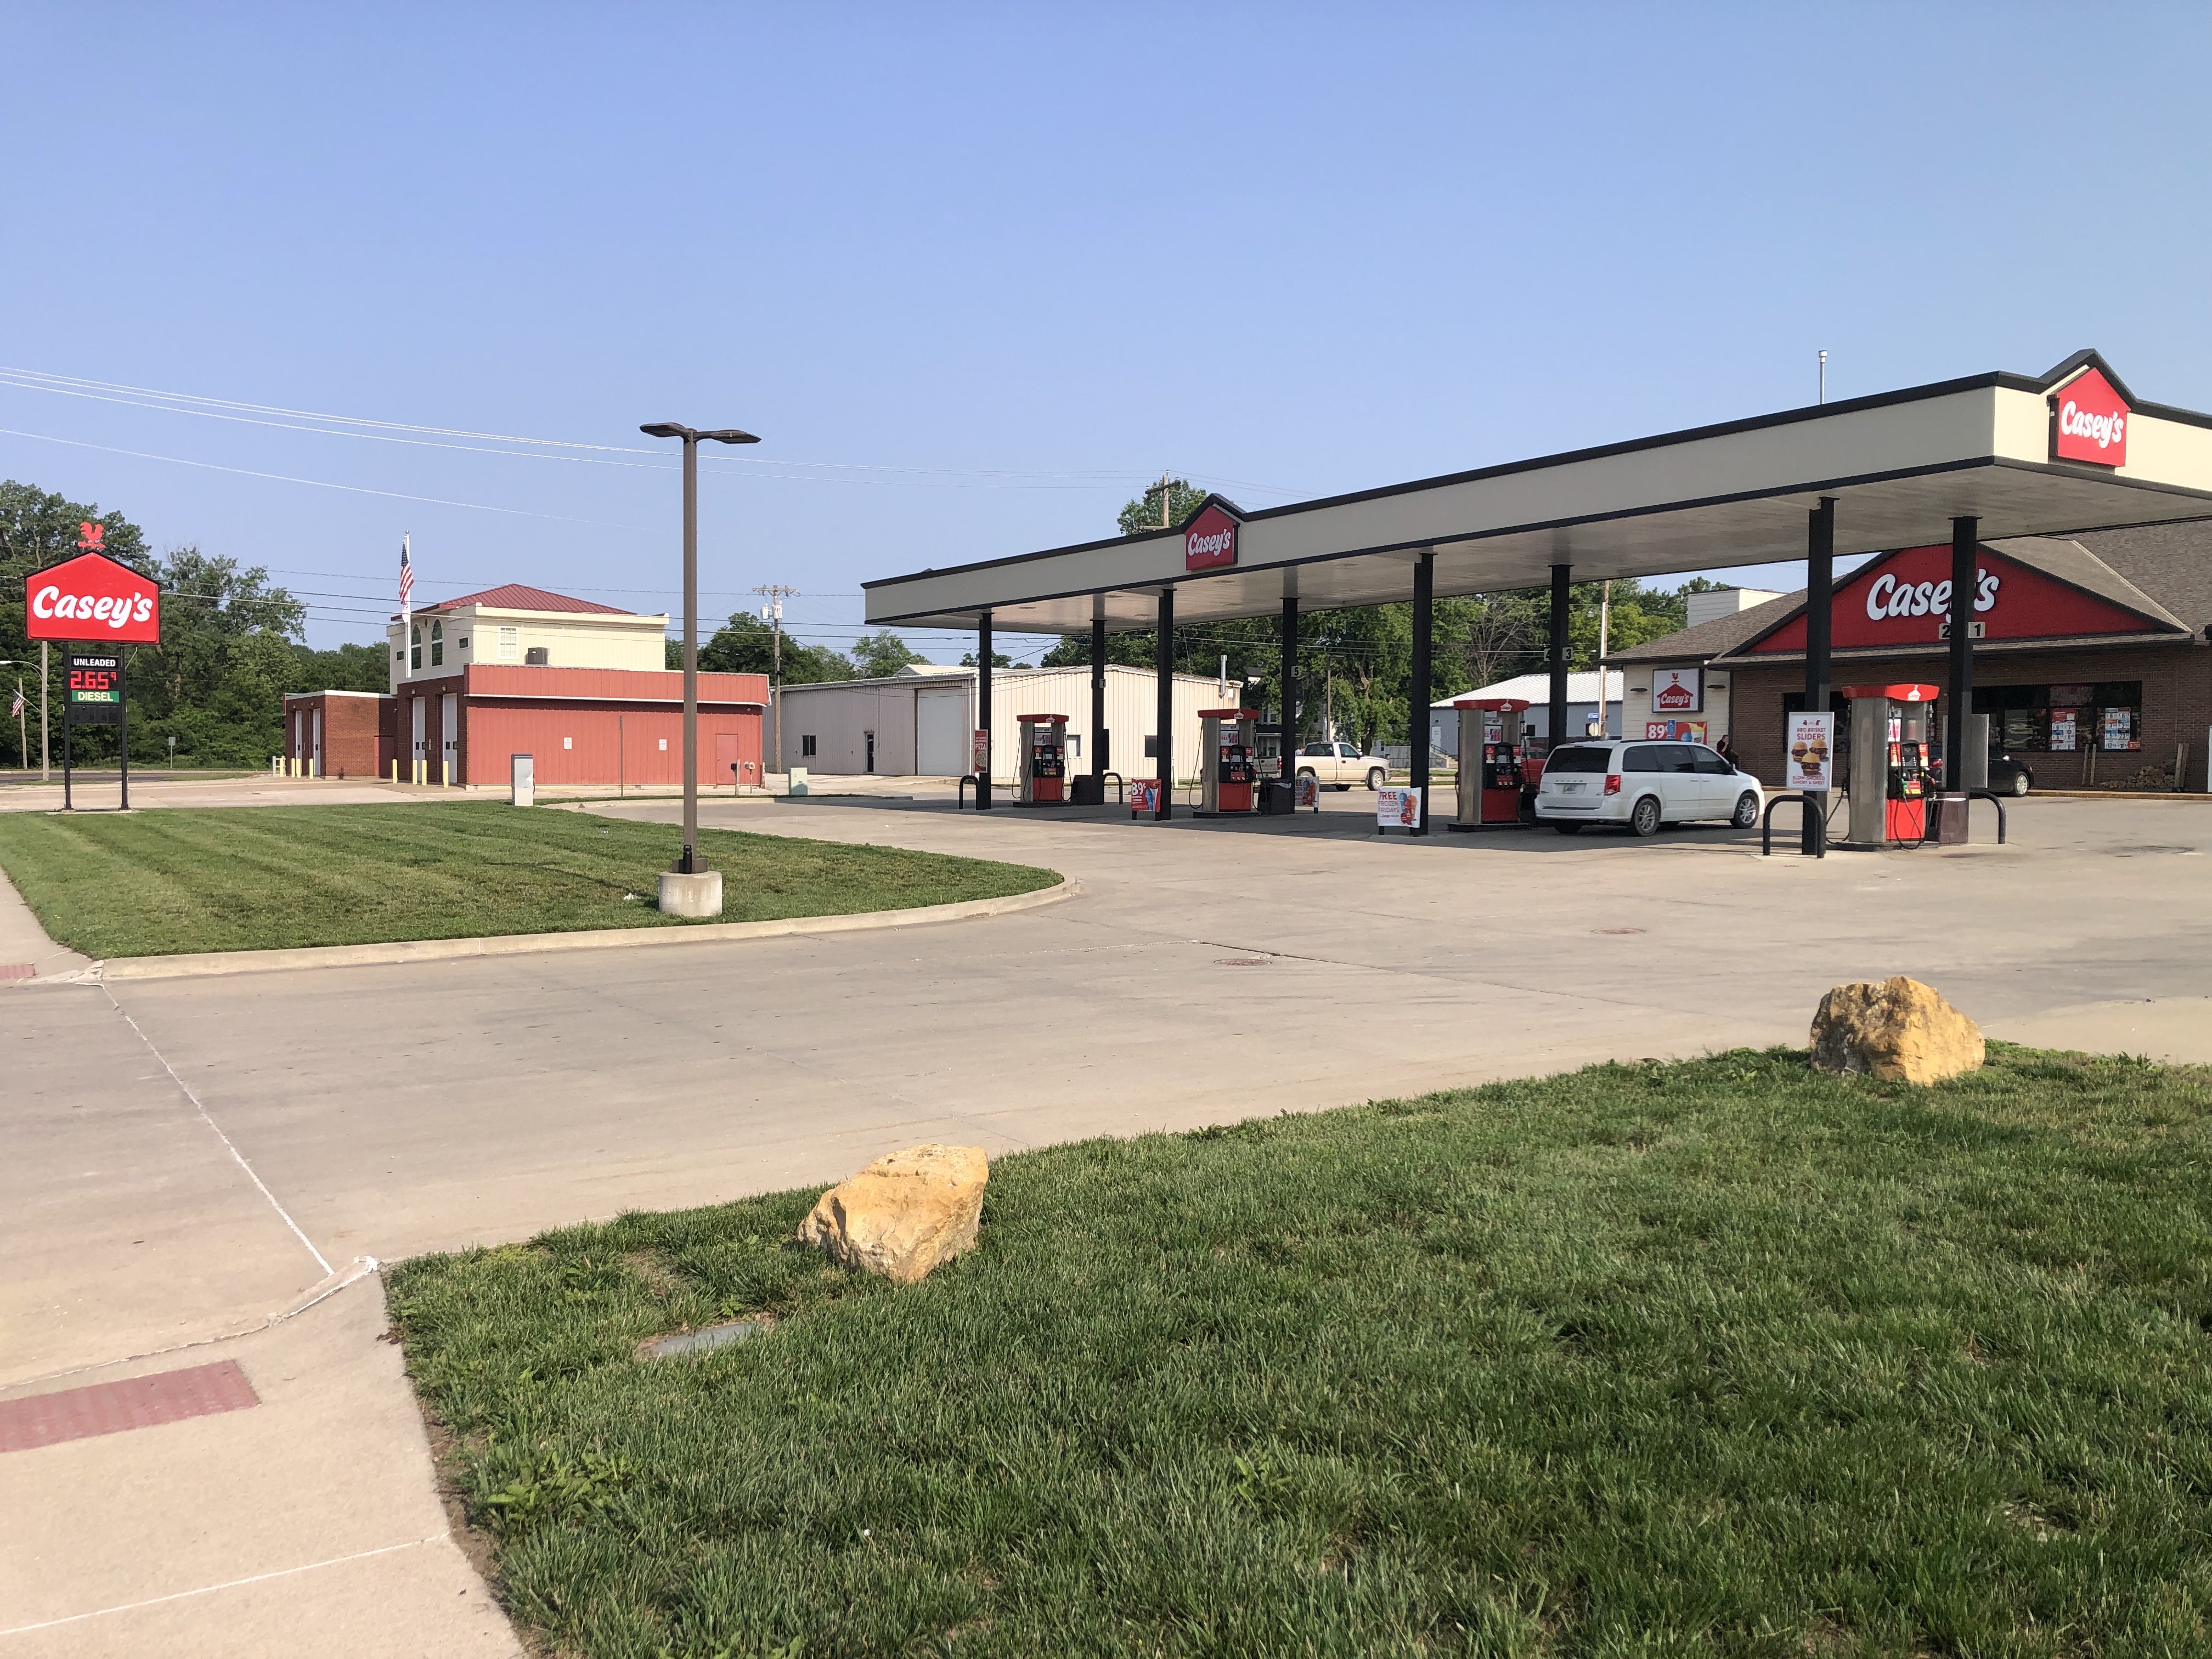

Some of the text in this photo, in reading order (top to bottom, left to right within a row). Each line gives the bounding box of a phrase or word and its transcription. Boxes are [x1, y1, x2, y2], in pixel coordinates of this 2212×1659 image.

[2061, 400, 2124, 449] Casey's
[1188, 528, 1231, 556] Casey's
[1866, 568, 2000, 623] Case's
[33, 585, 153, 628] Casey's
[1942, 625, 1951, 638] 2
[1974, 624, 1981, 637] 1
[1566, 648, 1572, 659] 3
[74, 658, 116, 667] UNLEADED
[1294, 667, 1299, 675] 5
[78, 692, 114, 701] DIESEL
[1661, 693, 1689, 706] Casey's
[1379, 791, 1397, 800] FREE
